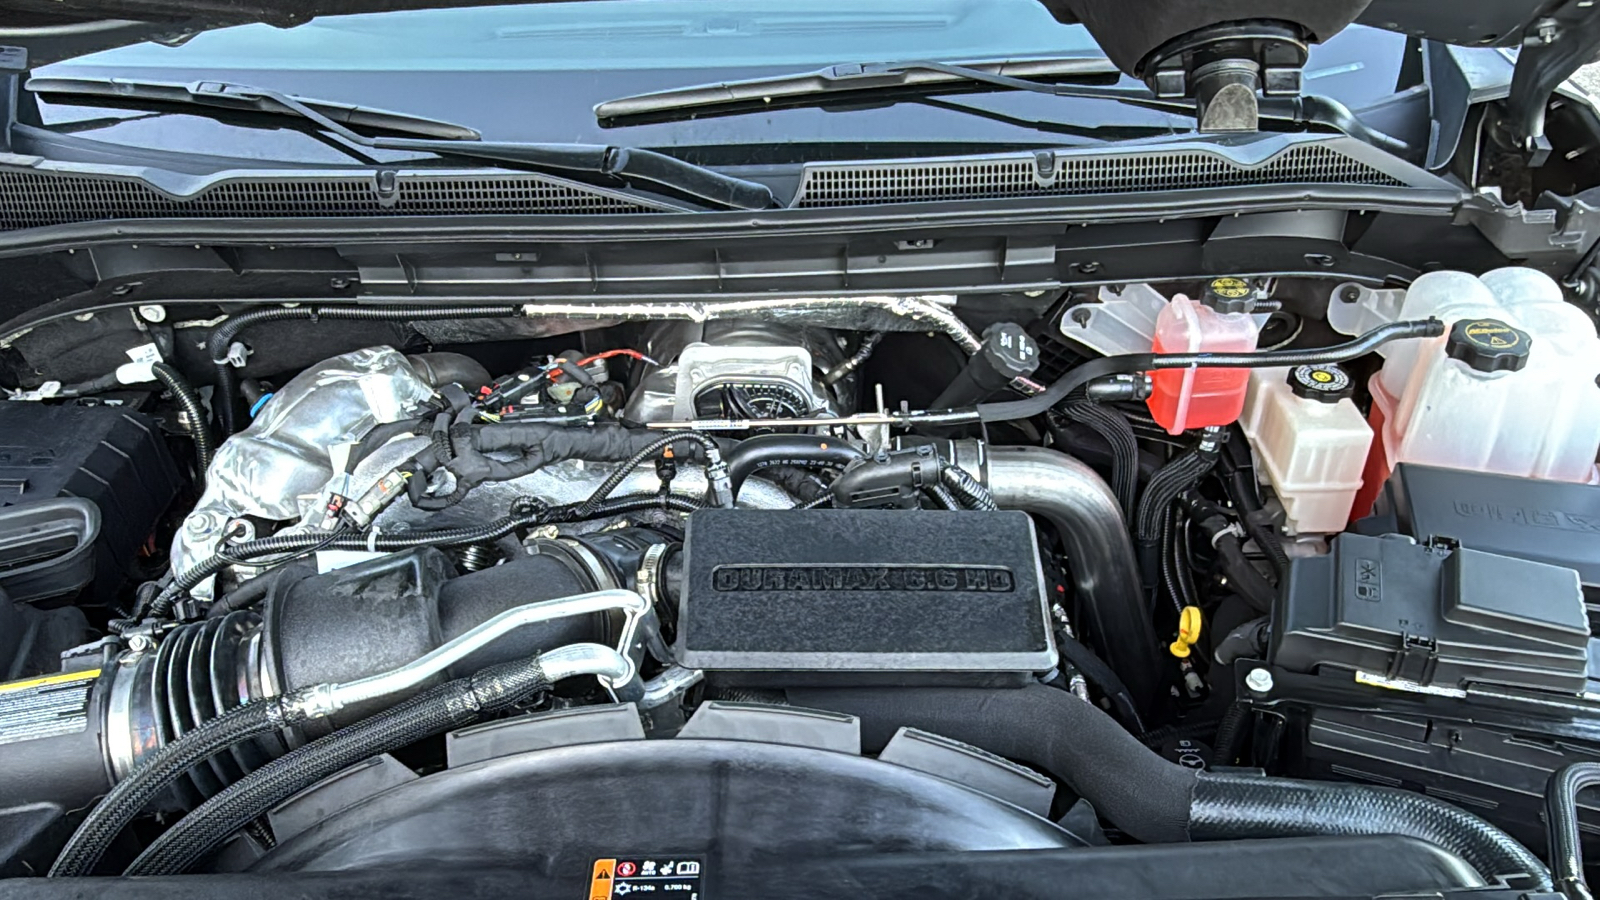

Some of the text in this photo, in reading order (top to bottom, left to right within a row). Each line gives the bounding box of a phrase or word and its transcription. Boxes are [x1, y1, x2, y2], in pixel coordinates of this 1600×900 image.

[716, 568, 1012, 591] DURAMAX 6.6 HD
[632, 884, 655, 892] R-134a
